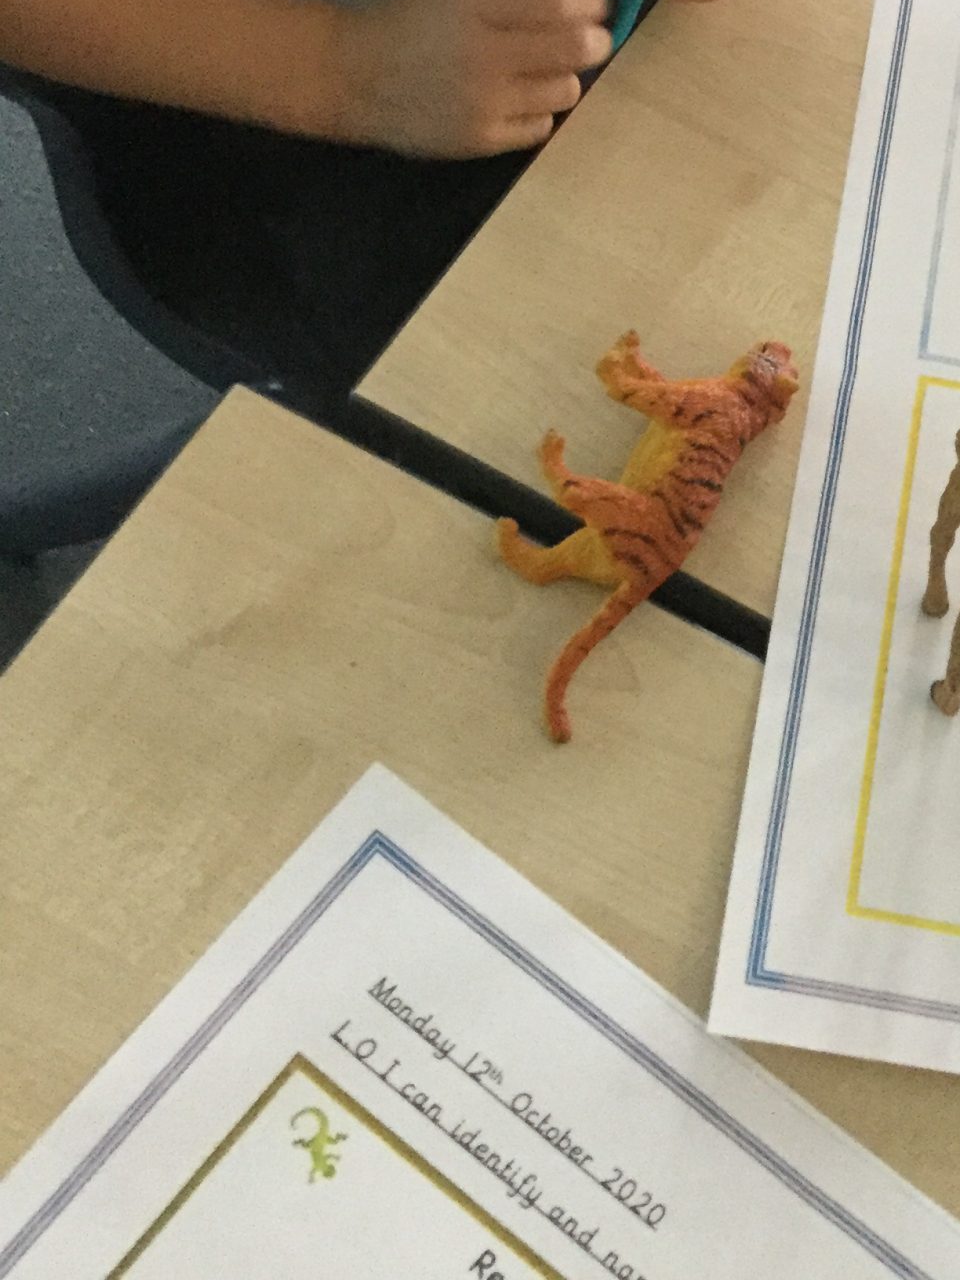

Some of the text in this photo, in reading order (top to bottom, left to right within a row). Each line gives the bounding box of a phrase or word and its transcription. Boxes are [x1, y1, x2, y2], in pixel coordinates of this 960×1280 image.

[367, 976, 667, 1231] Monday 12th October 2020
[379, 1058, 402, 1082] I
[400, 1082, 443, 1123] can
[449, 1119, 543, 1210] identify
[549, 1206, 600, 1254] and
